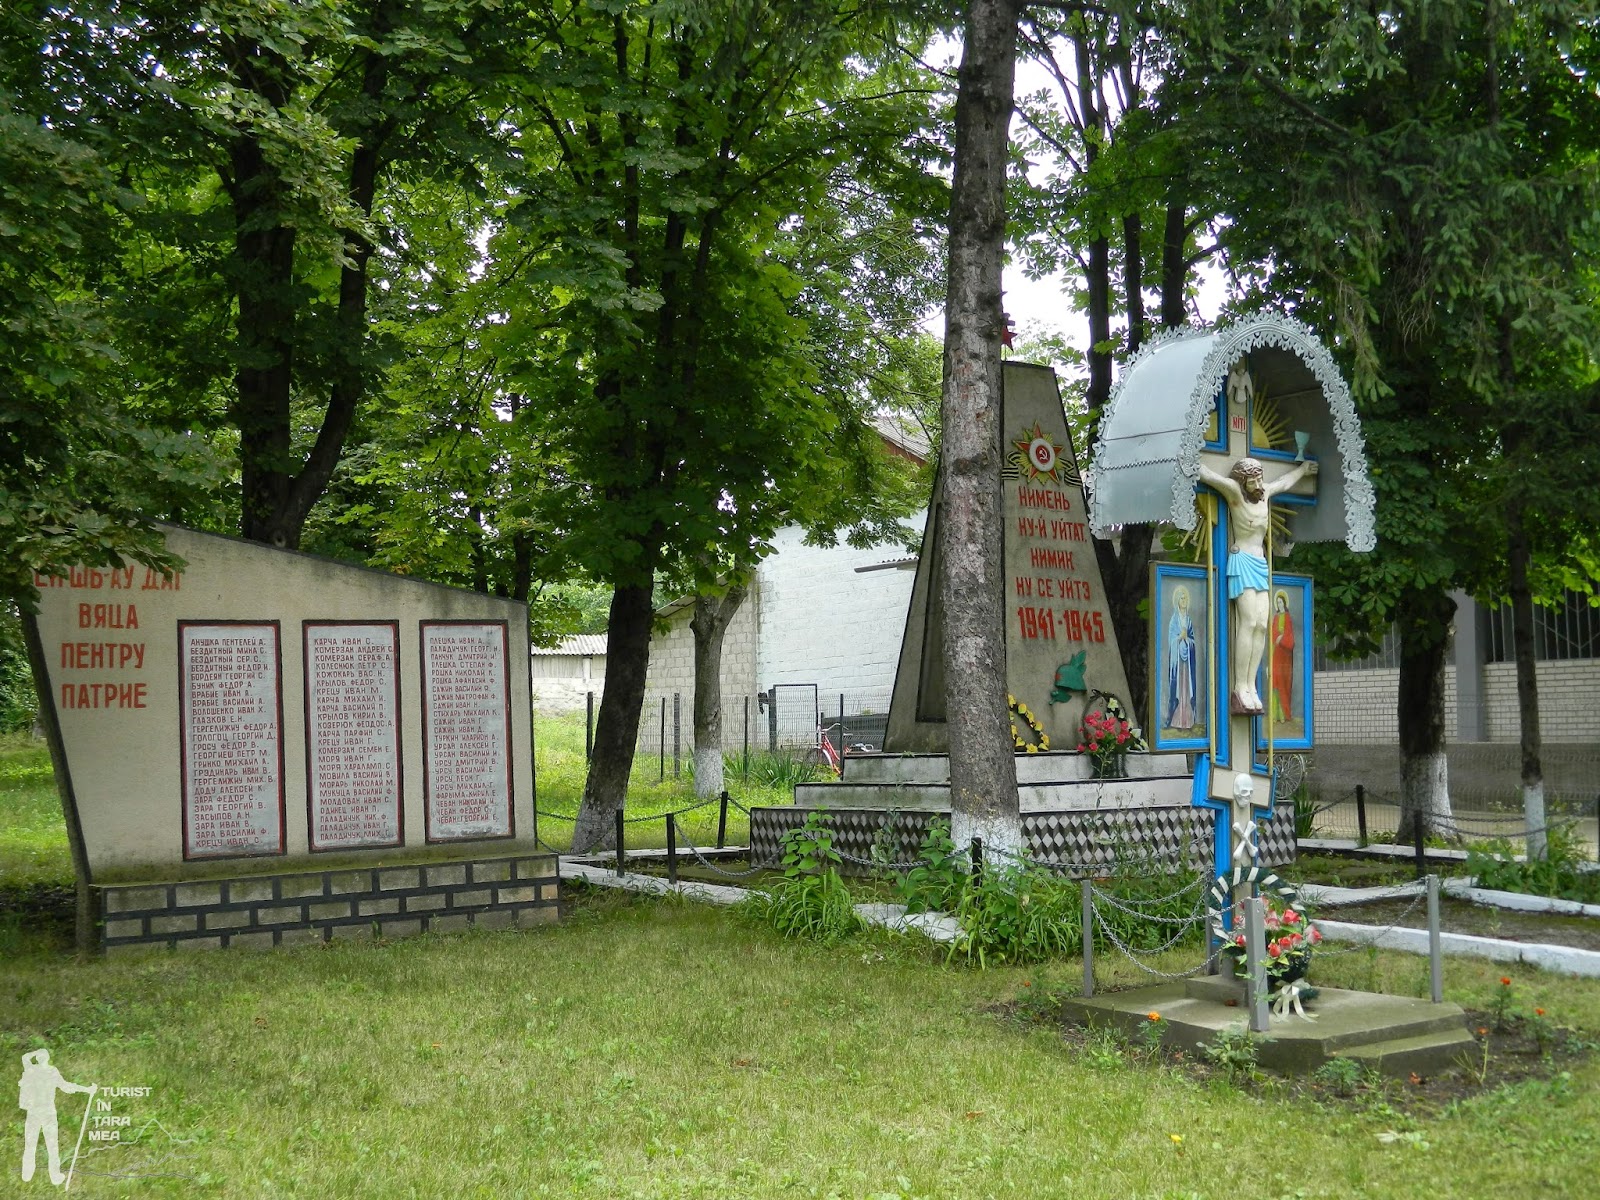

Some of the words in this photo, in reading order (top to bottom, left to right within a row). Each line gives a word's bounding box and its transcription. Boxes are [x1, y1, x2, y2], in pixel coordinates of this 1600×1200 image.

[1018, 486, 1070, 511] НИМЕНЬ
[1018, 515, 1048, 538] НУ-Й
[1016, 576, 1032, 597] НУ
[1038, 578, 1054, 598] СЕ
[1058, 576, 1090, 600] УЙТЭ
[79, 603, 138, 629] ВЯЦА
[61, 642, 145, 668] ПЕНТРУ
[62, 683, 148, 708] ПАТРИЕ
[225, 759, 258, 767] МИХАИЛ
[217, 794, 244, 803] ФЕДОР
[320, 797, 360, 806] МОЛДОВАН
[196, 839, 222, 848] КРЕЦУ
